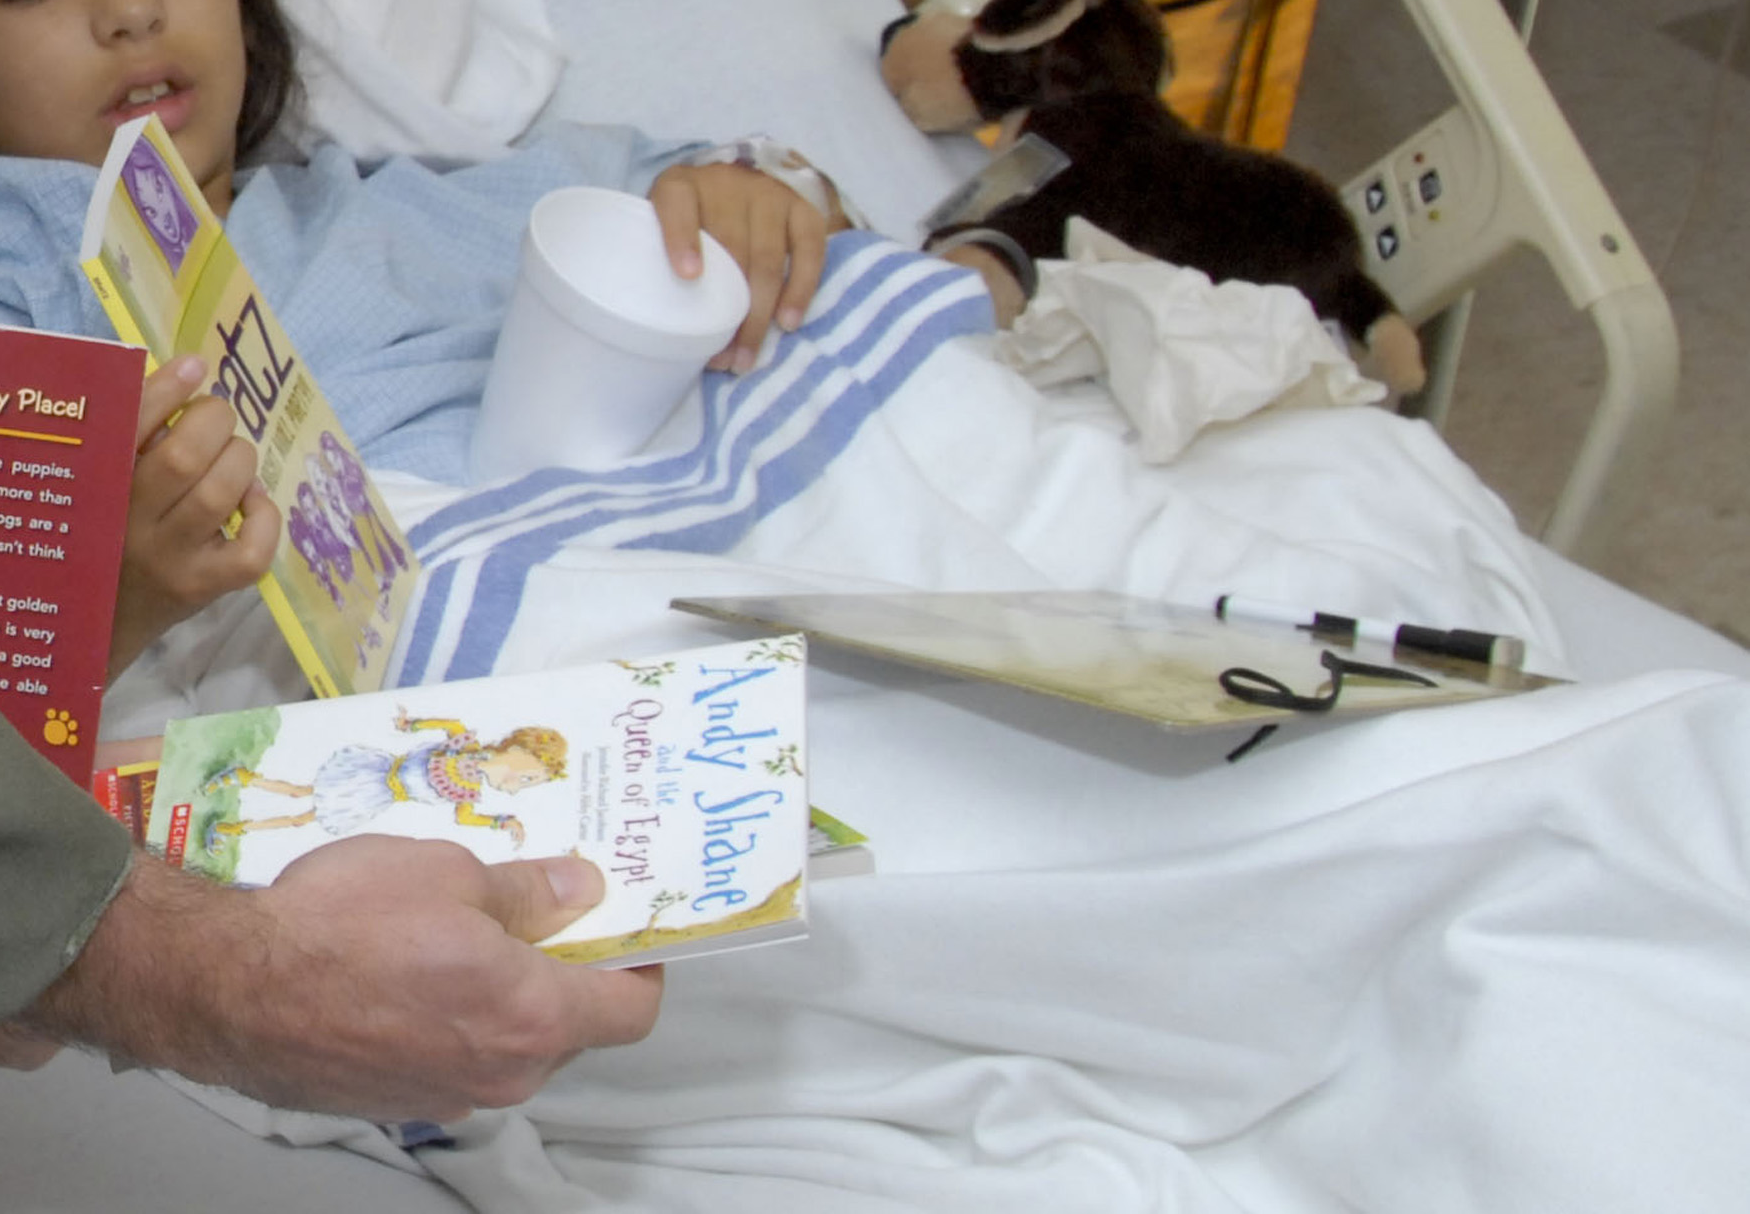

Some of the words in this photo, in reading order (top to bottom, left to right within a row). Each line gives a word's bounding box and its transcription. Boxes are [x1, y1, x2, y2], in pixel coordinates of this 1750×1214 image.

[211, 293, 294, 443] atz
[12, 461, 75, 480] puppies.
[39, 489, 72, 505] than
[29, 519, 53, 531] are
[59, 523, 69, 534] a
[29, 543, 65, 560] think
[7, 597, 59, 614] golden
[6, 622, 16, 637] is
[24, 628, 56, 645] very
[12, 654, 52, 668] good
[16, 679, 48, 694] able
[685, 664, 778, 770] Andy
[611, 699, 663, 773] Queen
[655, 745, 683, 774] and
[621, 784, 651, 807] of
[655, 781, 681, 807] the
[611, 814, 661, 886] Egypt
[692, 789, 783, 911] Shane
